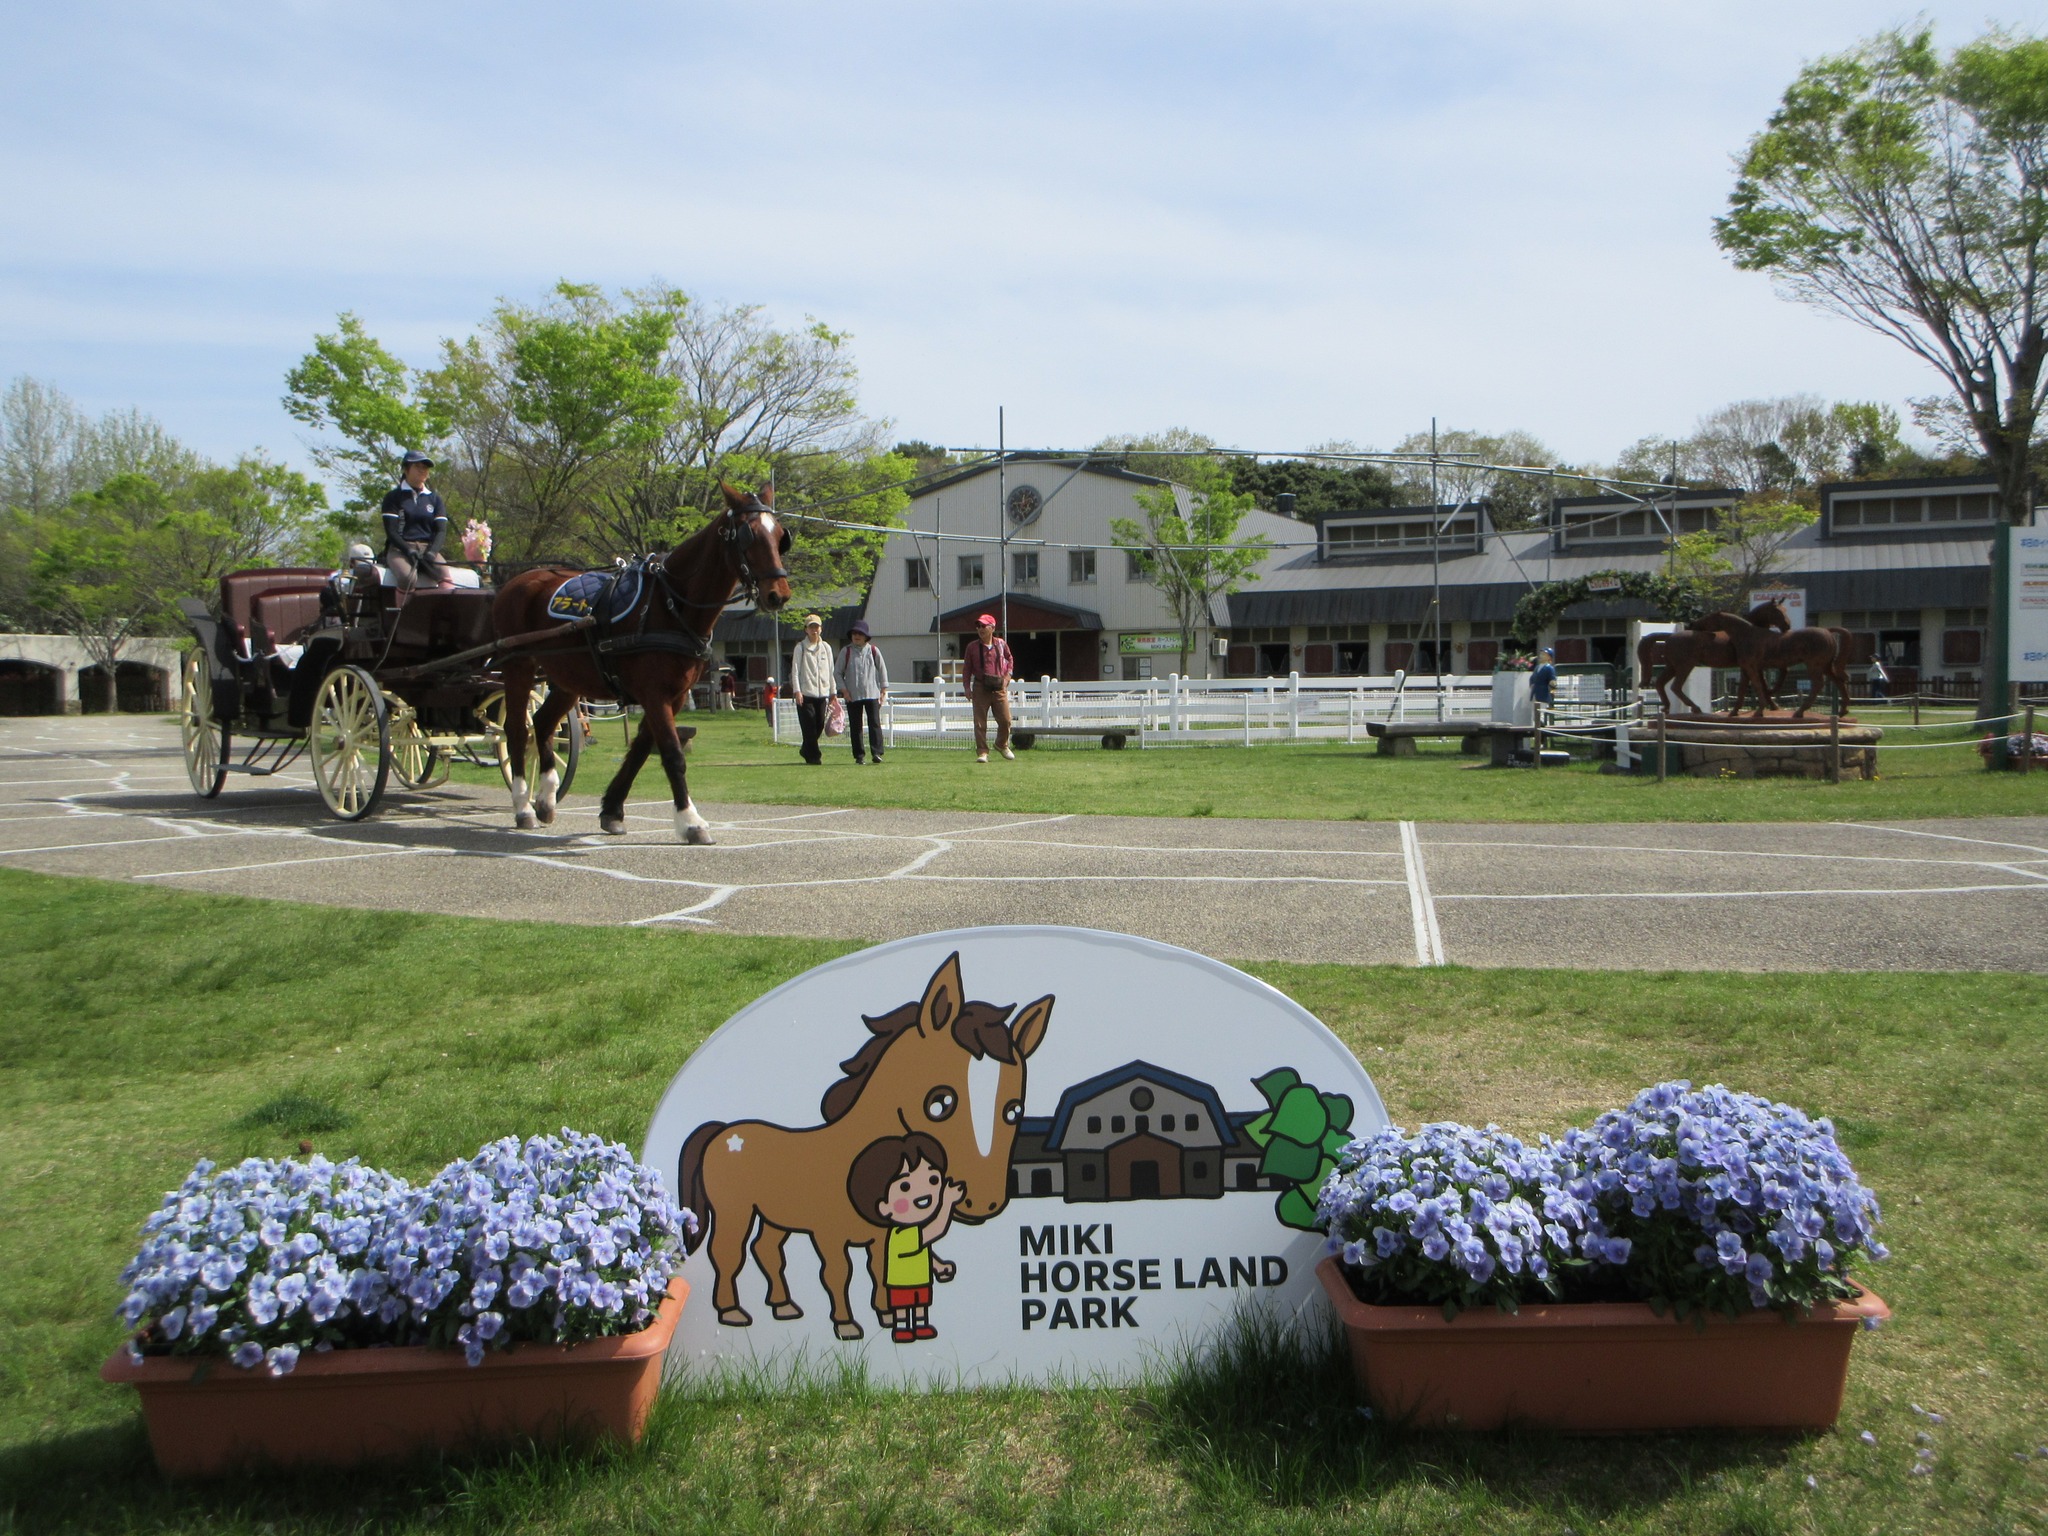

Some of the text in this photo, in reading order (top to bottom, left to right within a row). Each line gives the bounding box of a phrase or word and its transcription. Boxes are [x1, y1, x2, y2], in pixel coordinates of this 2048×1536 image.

[551, 597, 588, 611] アラート
[1019, 1223, 1113, 1256] MIKI
[1020, 1255, 1289, 1293] HORSE LAND
[1021, 1296, 1140, 1331] PARK
